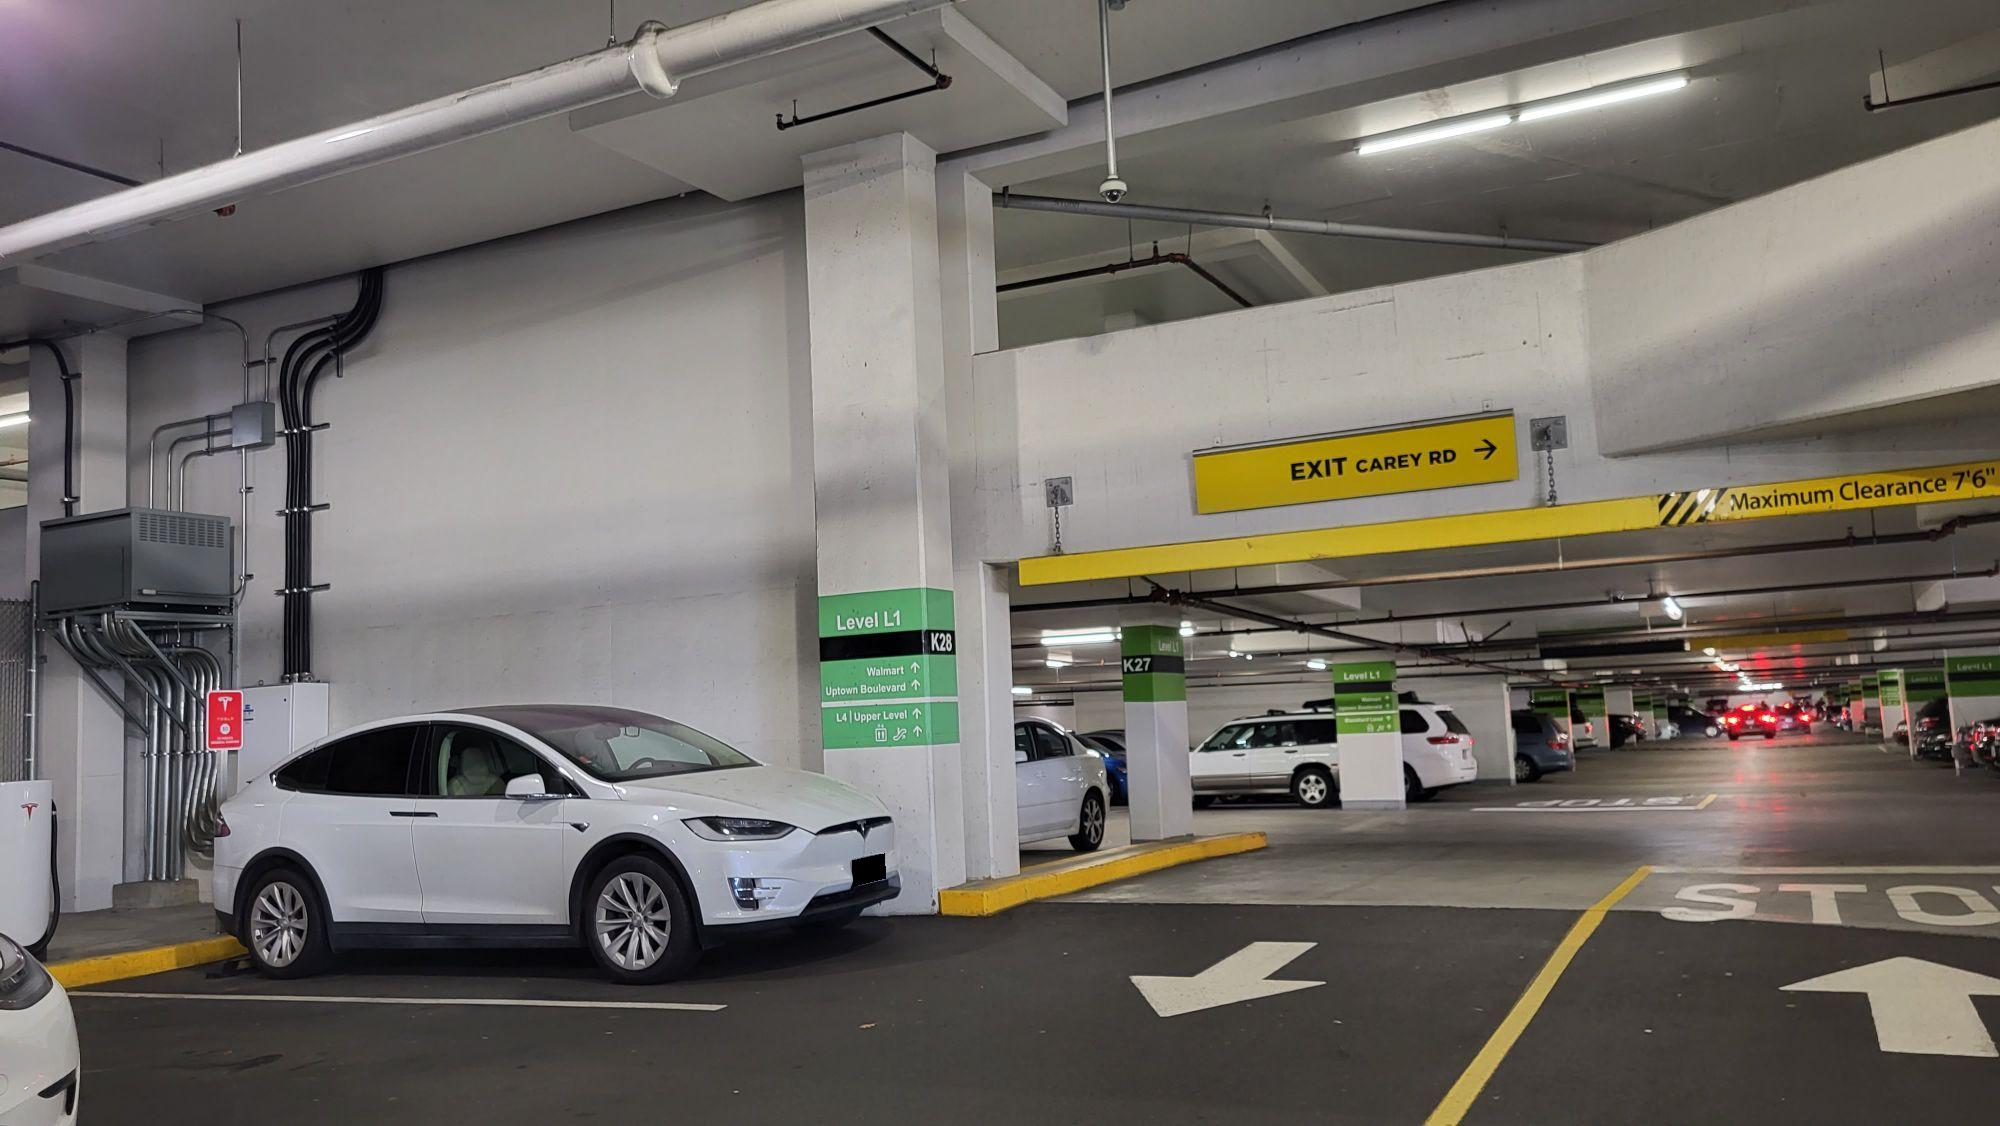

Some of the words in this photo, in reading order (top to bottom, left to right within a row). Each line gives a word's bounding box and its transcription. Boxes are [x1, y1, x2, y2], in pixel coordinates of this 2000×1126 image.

[1290, 456, 1348, 482] EXIT
[1355, 452, 1422, 474] CAREY
[1428, 449, 1457, 466] RD
[1730, 489, 1834, 513] Maximum
[1839, 477, 1948, 502] Clearance
[836, 611, 878, 631] Level
[884, 609, 901, 628] L1
[930, 632, 953, 652] K28
[866, 665, 905, 677] Walmart
[1123, 657, 1152, 673] K27
[1343, 671, 1368, 681] Level
[1369, 670, 1381, 680] L1
[825, 686, 858, 698] Uptown
[860, 682, 907, 694] Boulevard
[836, 712, 848, 723] L4
[854, 711, 881, 724] Upper
[883, 709, 908, 721] Level
[1660, 882, 2000, 927] STO
